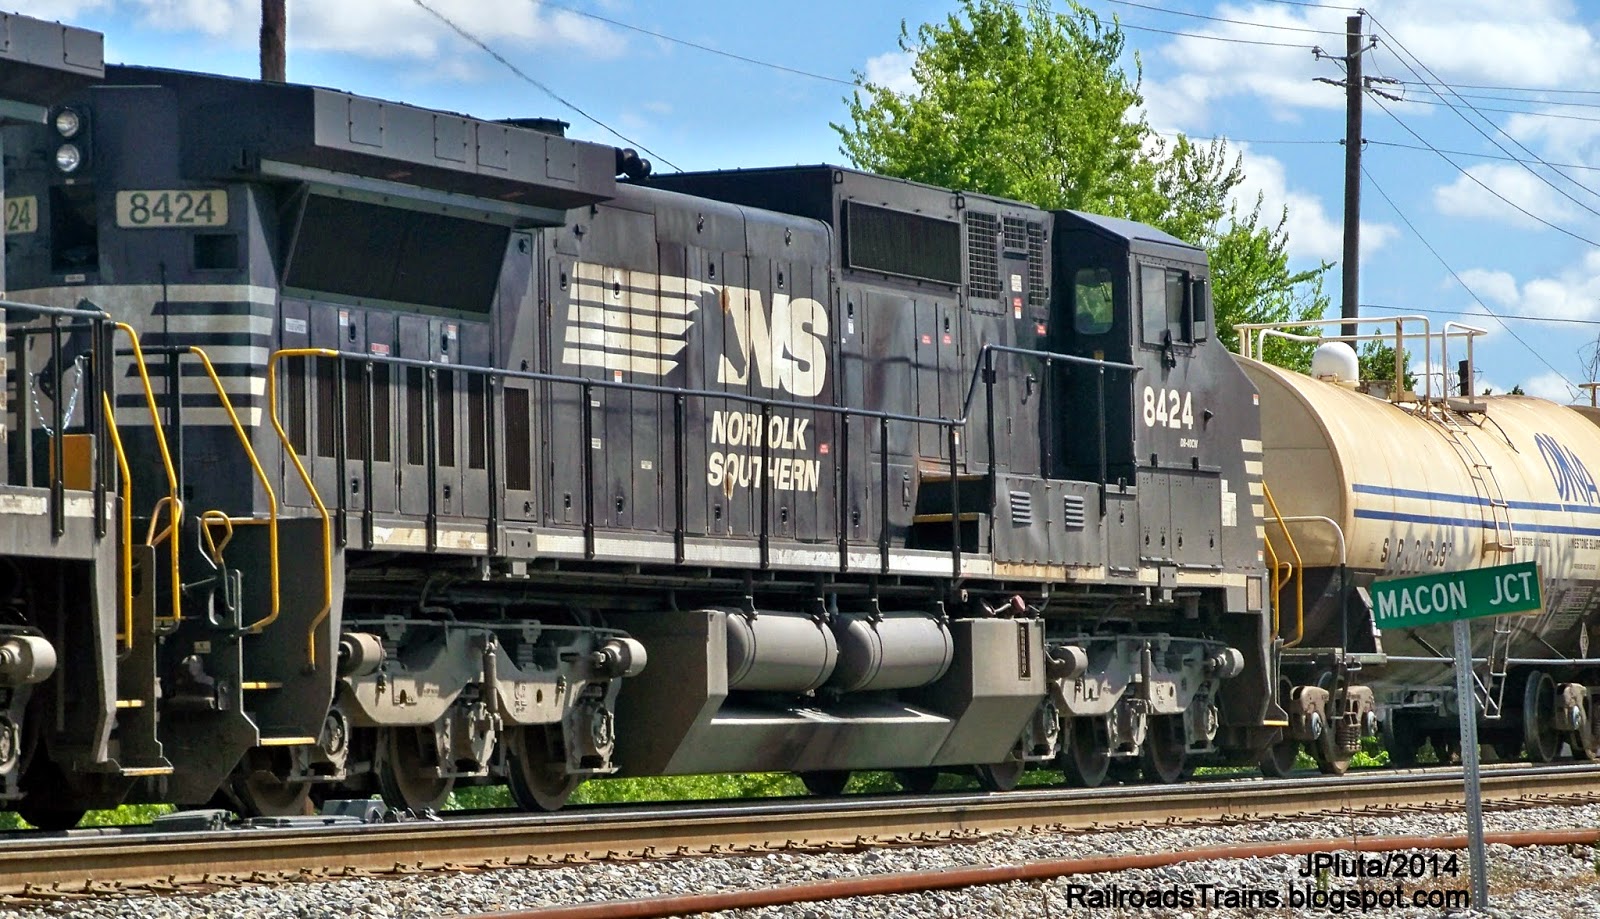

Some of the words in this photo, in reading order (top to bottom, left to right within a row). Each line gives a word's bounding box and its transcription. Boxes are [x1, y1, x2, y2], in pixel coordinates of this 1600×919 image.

[5, 200, 31, 231] 24
[129, 192, 216, 223] 8424
[717, 284, 829, 397] NS
[1143, 386, 1194, 429] 8424
[707, 451, 821, 492] SOUTHERN
[1377, 580, 1467, 620] MACON
[1489, 571, 1533, 606] JCT
